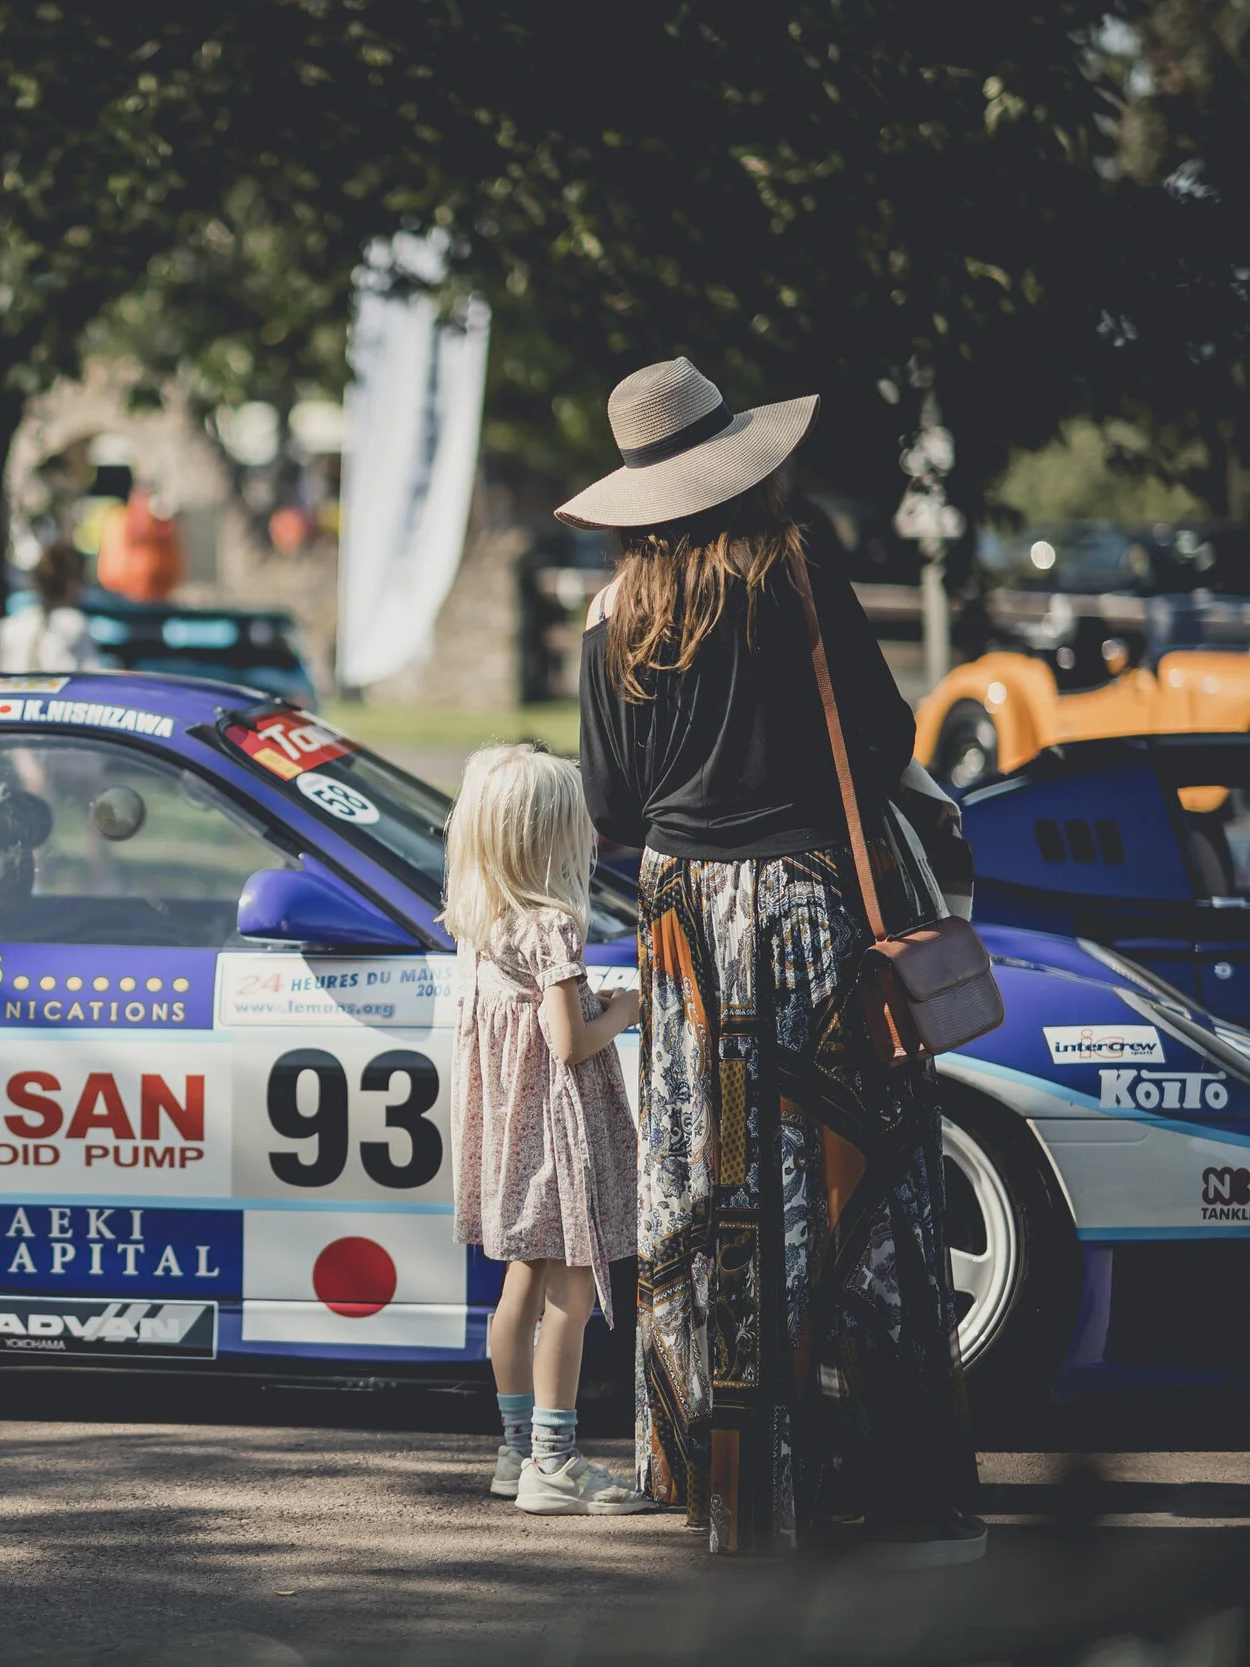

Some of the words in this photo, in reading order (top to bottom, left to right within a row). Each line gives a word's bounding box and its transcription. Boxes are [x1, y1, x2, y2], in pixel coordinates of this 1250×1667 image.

[24, 700, 174, 738] K.NISHIZAWA
[237, 972, 285, 996] 24
[291, 973, 359, 991] HEURES
[366, 971, 391, 986] DU
[400, 966, 453, 983] MANS
[416, 984, 452, 998] 2006
[267, 1048, 443, 1189] 93
[85, 1145, 205, 1169] PUMP
[1201, 1207, 1250, 1220] TANKL
[5, 1338, 66, 1350] YOKOHAMA
